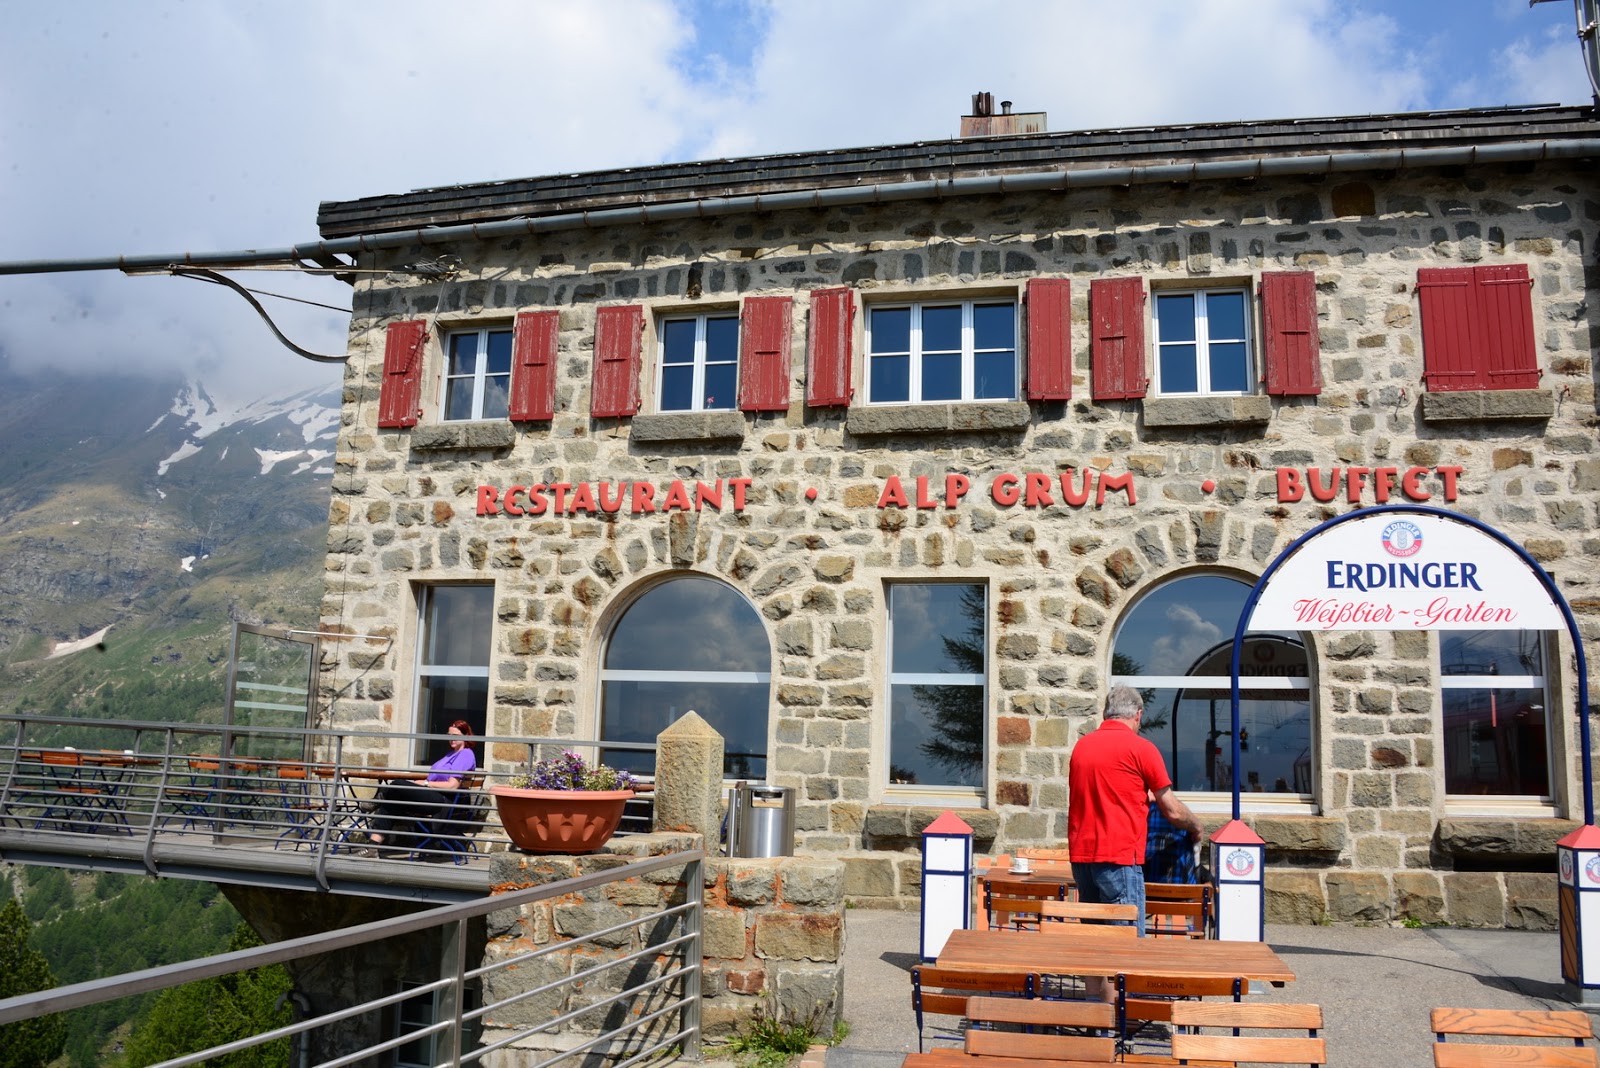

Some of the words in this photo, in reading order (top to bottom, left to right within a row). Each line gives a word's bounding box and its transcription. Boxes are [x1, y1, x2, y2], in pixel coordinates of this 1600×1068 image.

[476, 478, 752, 516] RESTAURANT
[877, 475, 970, 509] ALP
[991, 467, 1137, 508] GRÜM
[1276, 465, 1464, 503] BUFFET
[1383, 521, 1421, 538] ERDINGER
[1326, 560, 1483, 592] ERDINGER
[1413, 596, 1518, 627] Garten
